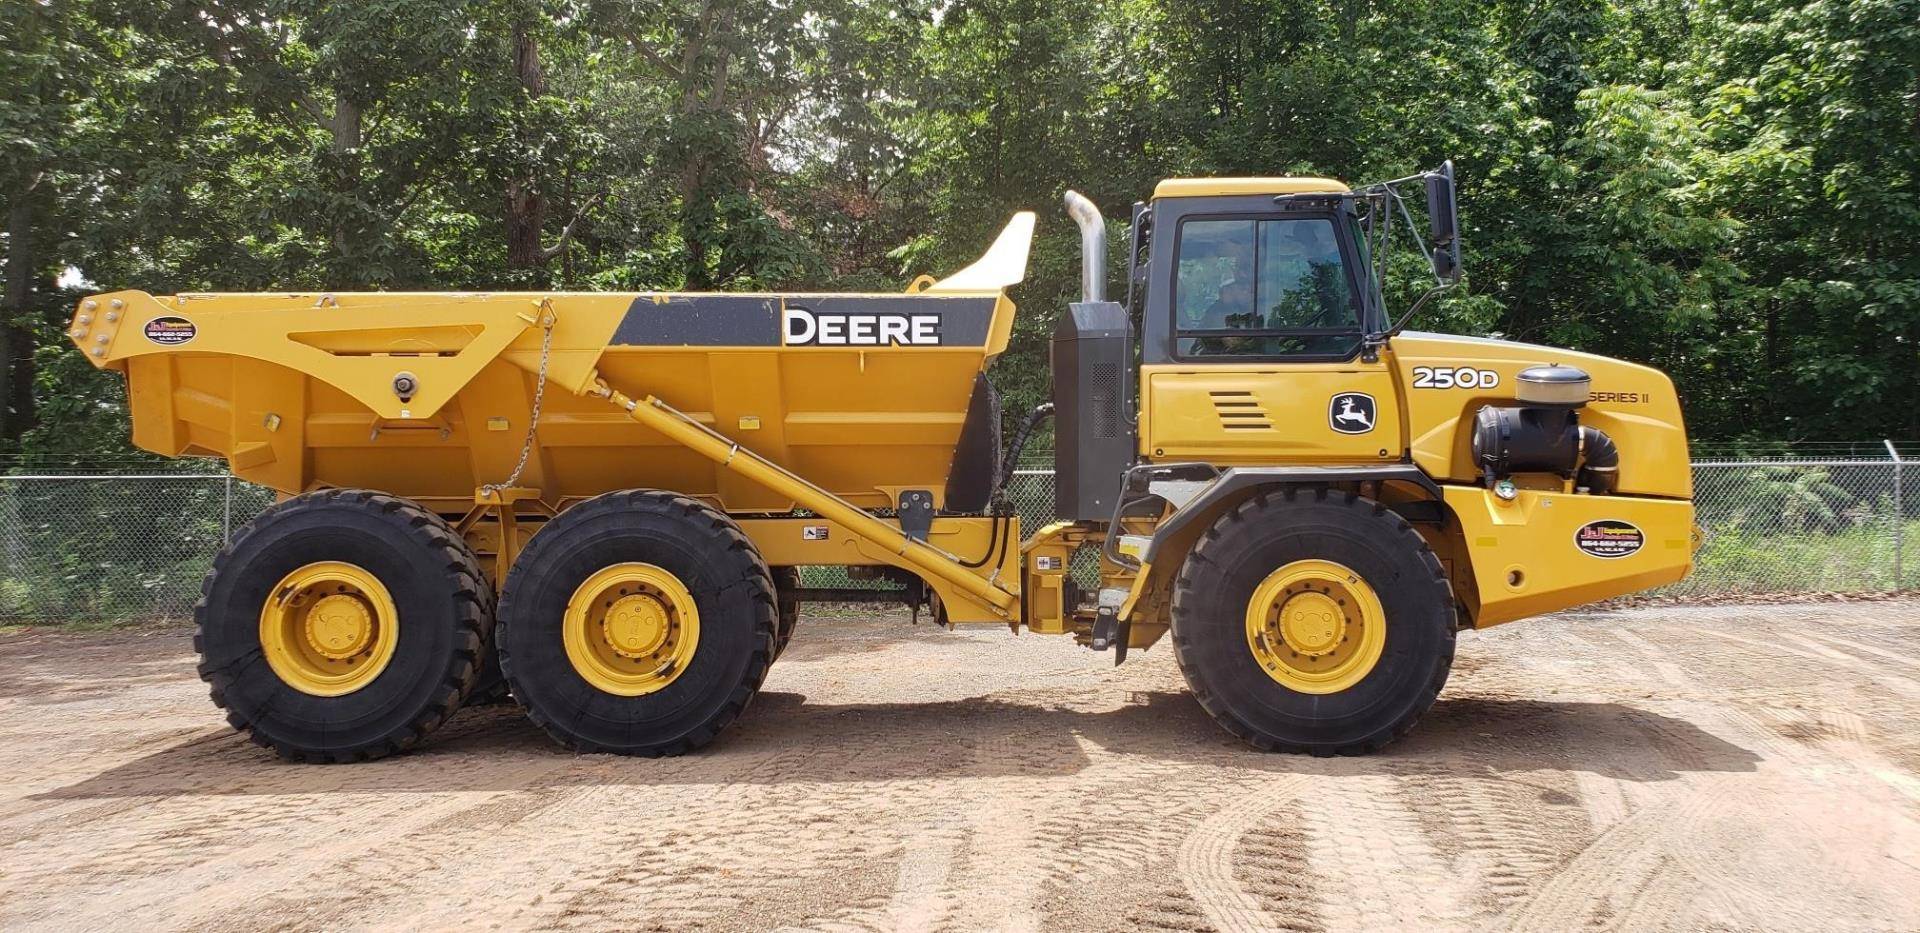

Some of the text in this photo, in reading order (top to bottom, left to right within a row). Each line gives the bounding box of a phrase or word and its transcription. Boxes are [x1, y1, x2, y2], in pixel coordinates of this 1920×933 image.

[784, 309, 939, 345] DEERE
[1413, 366, 1499, 389] 250D
[1589, 392, 1649, 403] SERIES II
